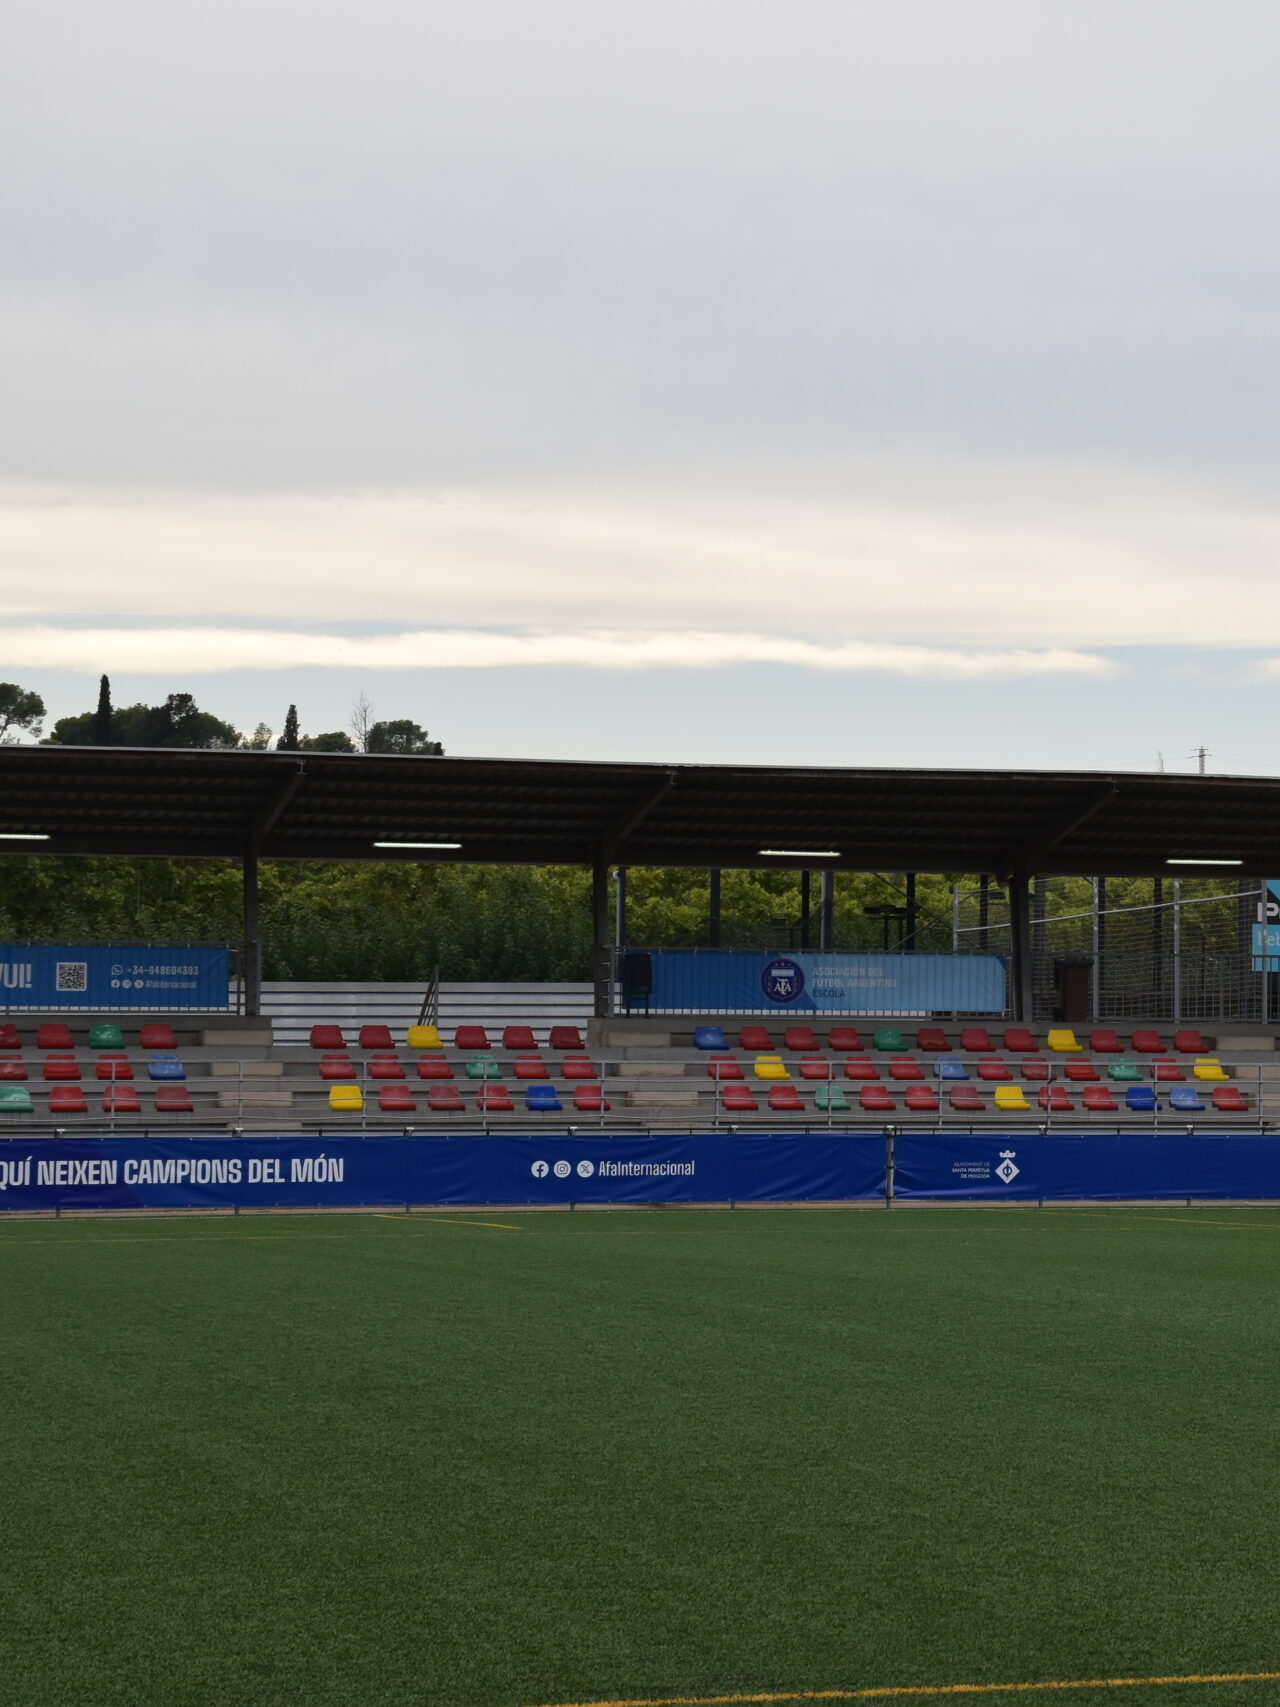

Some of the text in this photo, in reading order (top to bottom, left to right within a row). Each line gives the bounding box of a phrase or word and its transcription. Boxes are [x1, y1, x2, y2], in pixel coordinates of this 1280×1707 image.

[868, 967, 884, 977] DEL
[848, 979, 897, 988] ARGENTINO
[813, 990, 845, 998] ESCOLA
[37, 1160, 117, 1185] NEIXEN
[124, 1158, 242, 1184] CAMPIONS
[248, 1158, 285, 1183] DEL
[291, 1153, 344, 1183] MÓN
[598, 1160, 695, 1176] AfaInternacional
